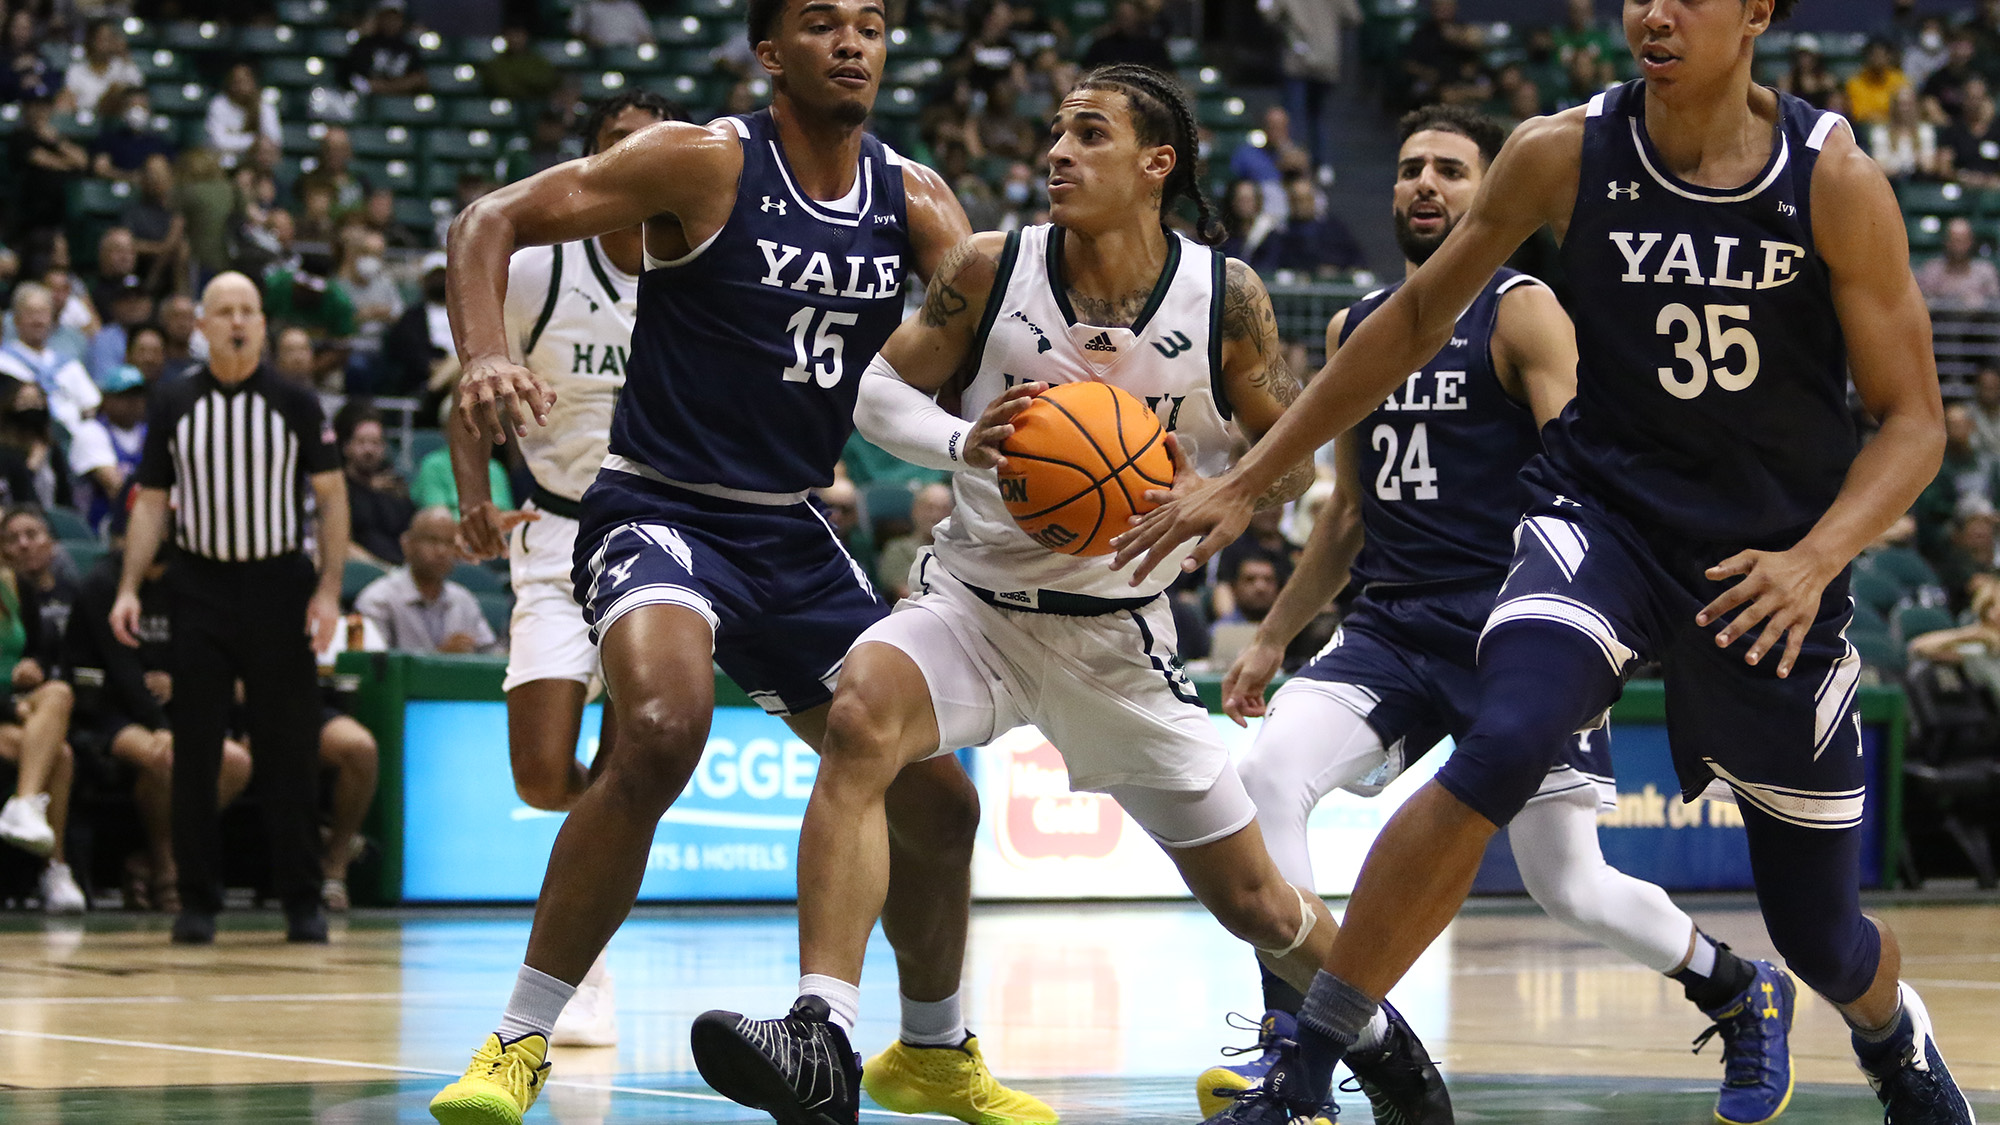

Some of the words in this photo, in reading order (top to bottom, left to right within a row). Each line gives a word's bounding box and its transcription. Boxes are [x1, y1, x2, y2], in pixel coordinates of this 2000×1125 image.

[756, 238, 900, 299] YALE
[1609, 231, 1806, 290] YALE
[782, 306, 859, 389] 15
[1084, 342, 1117, 352] adidas
[1656, 302, 1760, 400] 35
[1374, 371, 1467, 411] LE
[948, 430, 961, 461] adidas
[1372, 422, 1438, 500] 24
[701, 842, 788, 871] HOTELS
